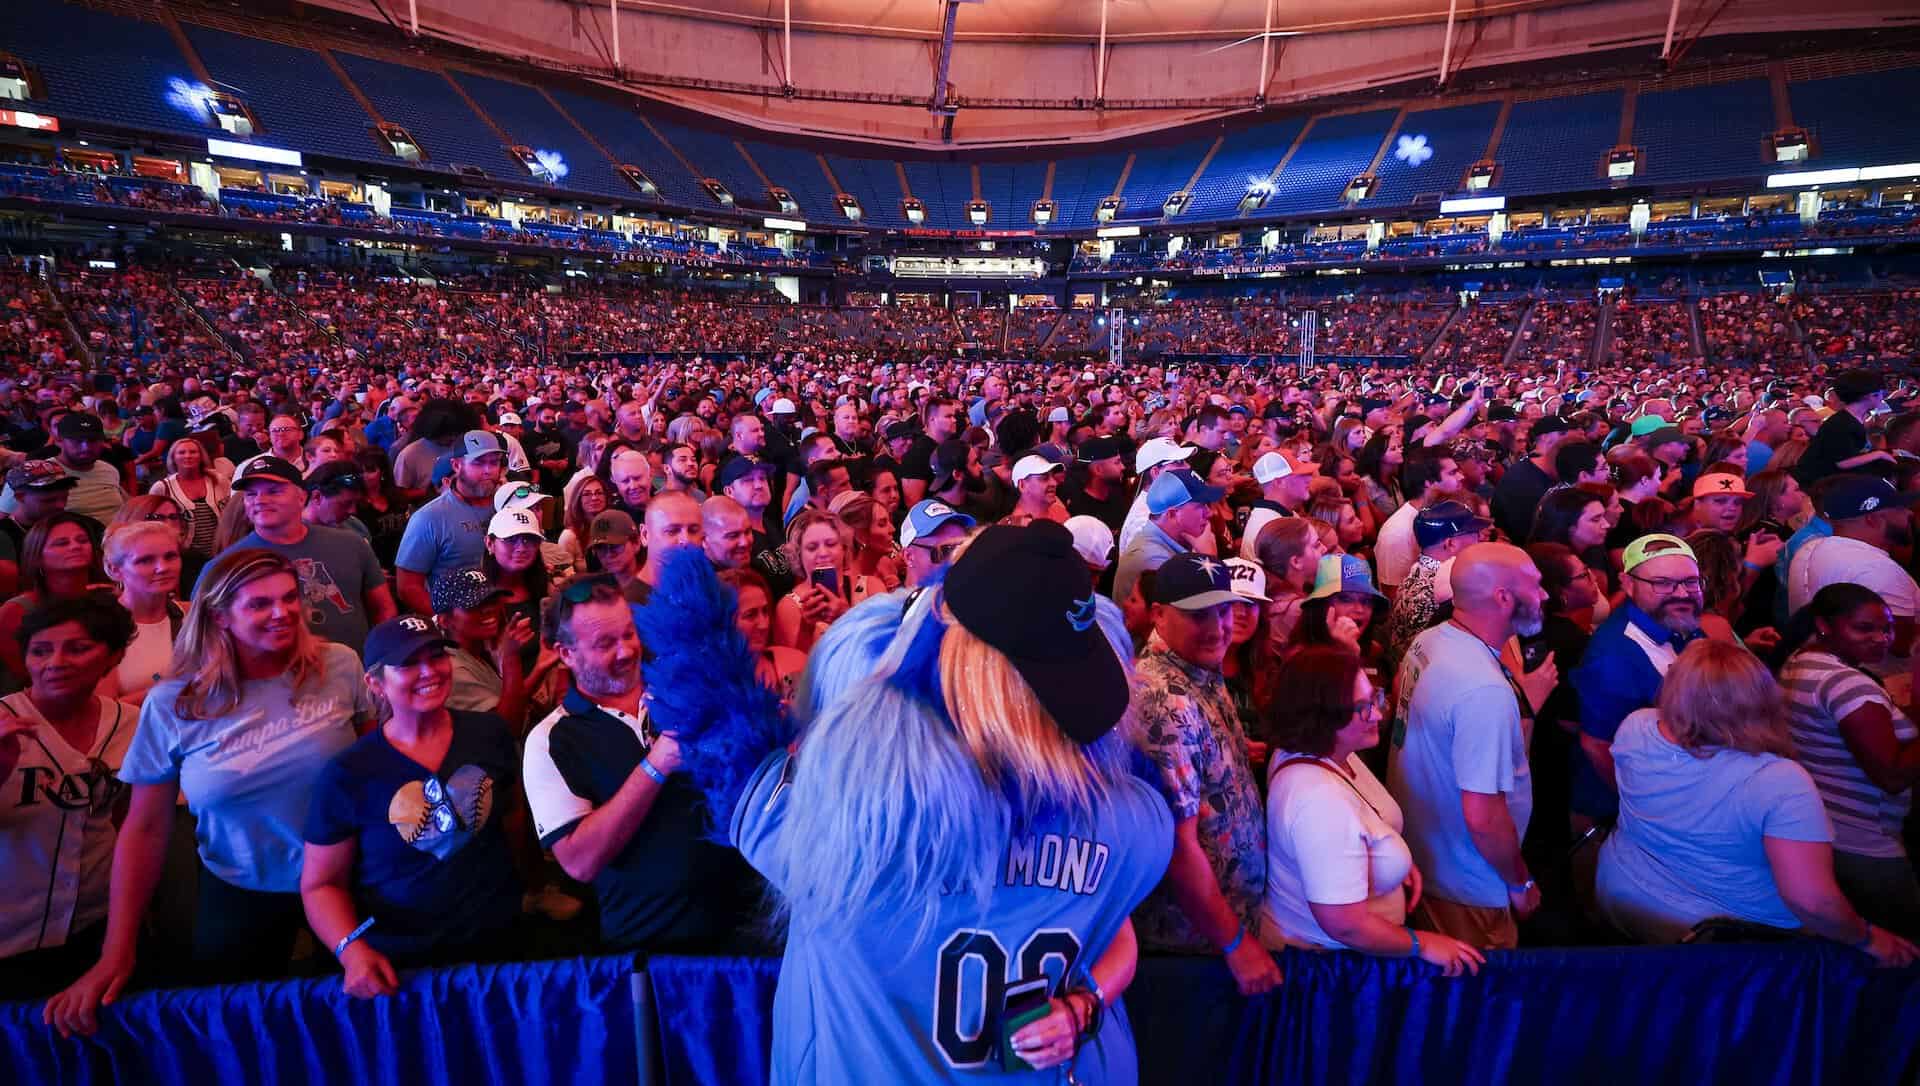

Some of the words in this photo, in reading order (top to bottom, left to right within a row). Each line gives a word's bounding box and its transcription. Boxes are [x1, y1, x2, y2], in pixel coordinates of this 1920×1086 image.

[903, 229, 950, 237] TROPICANA
[612, 252, 682, 265] AEROVANTI
[686, 259, 713, 268] CLUB
[1193, 266, 1222, 275] REPUBLIC
[1222, 265, 1241, 274] BANK
[1241, 265, 1263, 273] DRAFT
[1264, 263, 1287, 272] ROOM
[512, 512, 530, 524] TB
[1230, 564, 1257, 582] 727
[399, 616, 428, 631] TB
